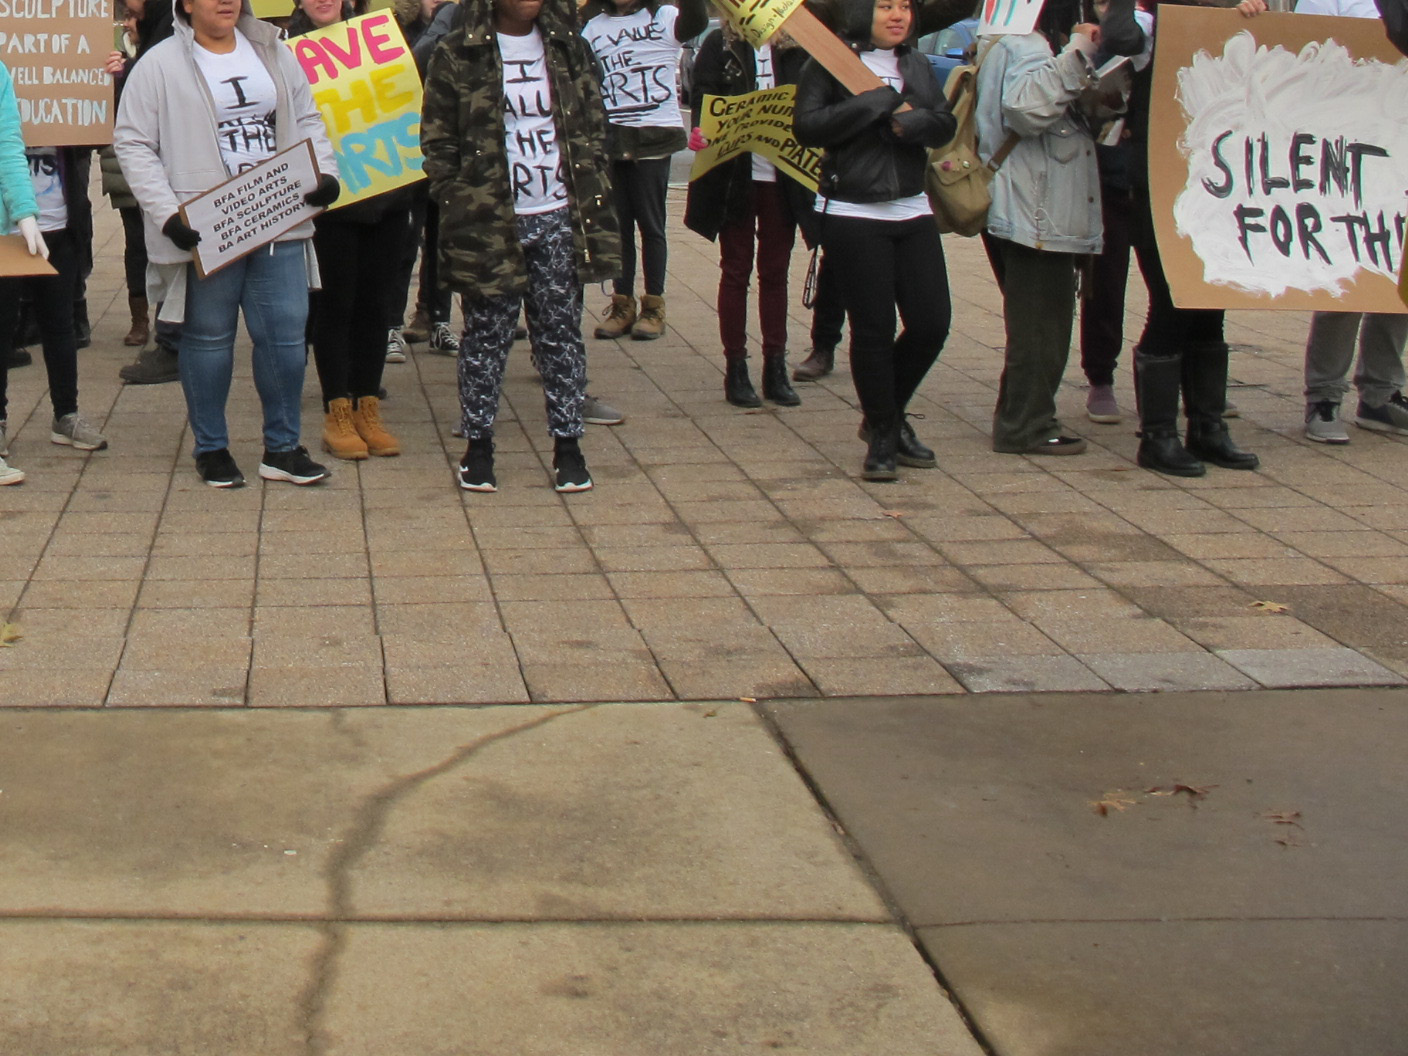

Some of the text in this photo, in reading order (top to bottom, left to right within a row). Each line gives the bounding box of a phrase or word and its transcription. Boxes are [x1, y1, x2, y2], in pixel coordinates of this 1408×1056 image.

[51, 34, 72, 54] OF
[77, 35, 91, 54] A
[606, 22, 666, 46] VALUE
[287, 15, 405, 84] AVE
[600, 50, 642, 73] THE
[43, 66, 112, 86] BALANCED
[502, 60, 543, 83] I
[755, 59, 773, 77] I
[220, 76, 260, 109] I
[504, 90, 552, 119] ALU
[710, 92, 790, 117] CERAMIC
[16, 98, 107, 126] DUCATION
[505, 130, 553, 158] HE
[755, 135, 781, 149] AND
[513, 161, 569, 202] RTS
[1201, 130, 1390, 211] SILENT
[213, 192, 236, 209] BFA
[237, 176, 264, 196] FILM
[266, 162, 289, 180] AND
[221, 175, 288, 216] VIDEO ARTS
[213, 180, 302, 233] BFA SCULPTURE
[220, 192, 300, 241] BFA CERAMICS
[218, 198, 308, 254] BA ART HISTORY
[1233, 202, 1333, 267] FOR
